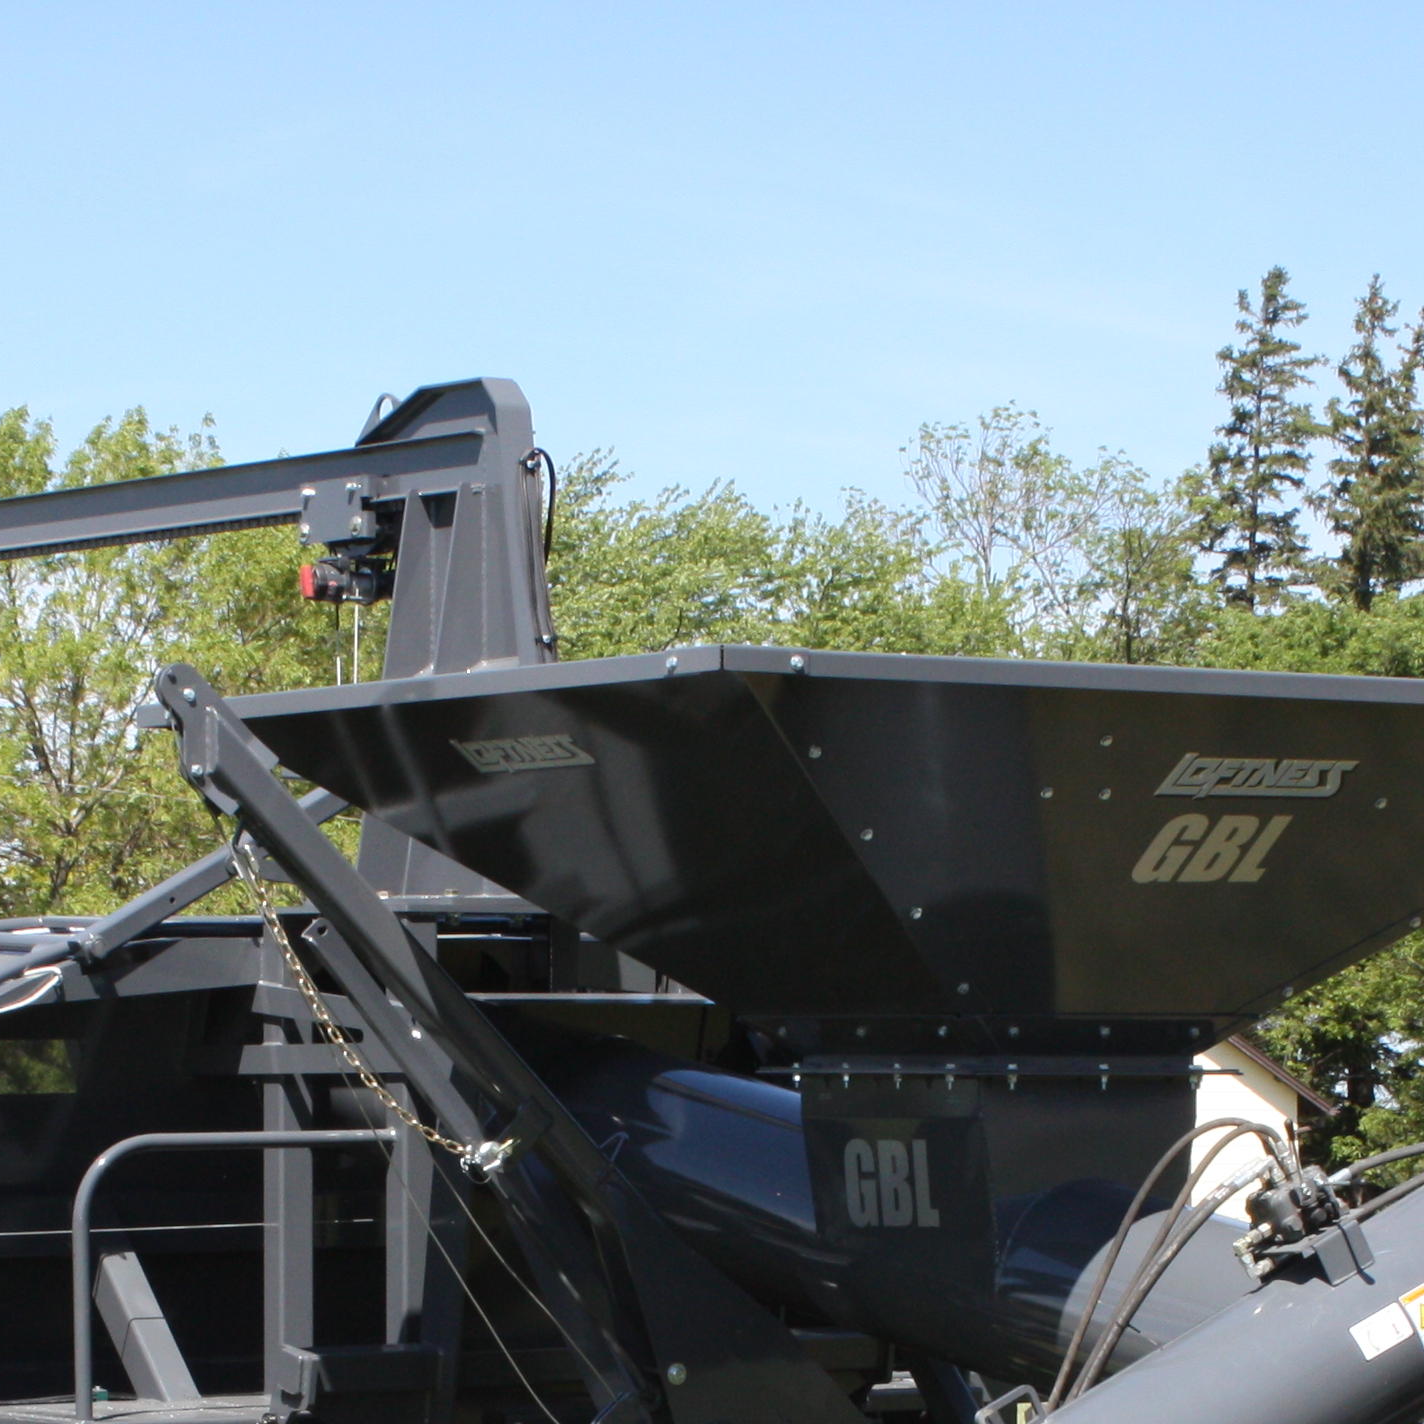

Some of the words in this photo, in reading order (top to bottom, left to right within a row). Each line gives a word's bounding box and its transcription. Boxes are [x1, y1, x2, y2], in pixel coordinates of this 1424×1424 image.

[1153, 752, 1361, 800] LOFTNESS
[1131, 813, 1294, 884] GBL
[843, 1138, 940, 1228] GBL
